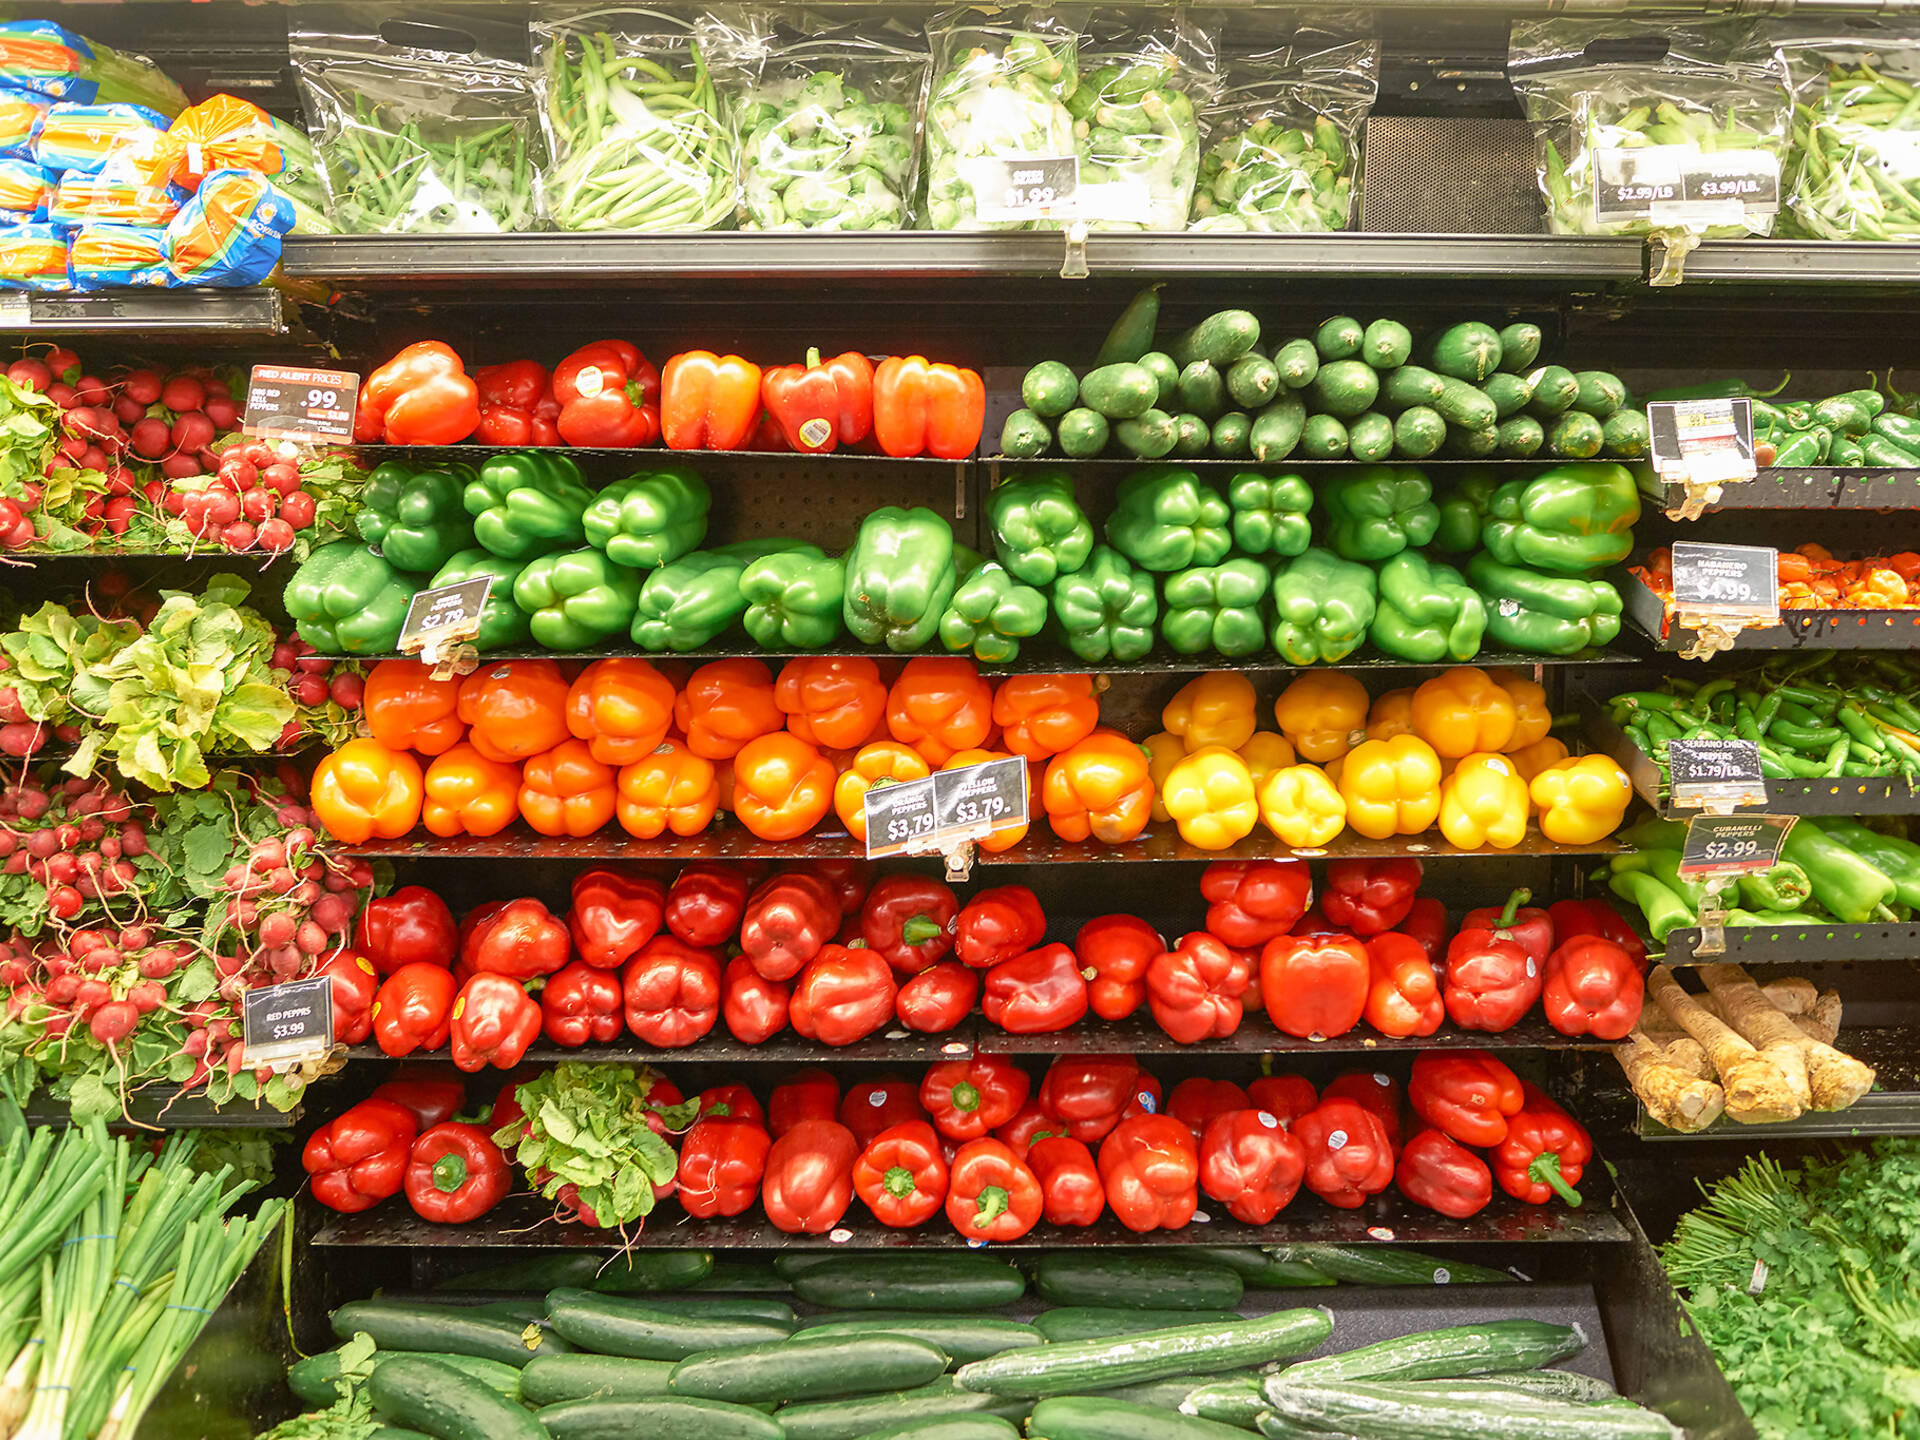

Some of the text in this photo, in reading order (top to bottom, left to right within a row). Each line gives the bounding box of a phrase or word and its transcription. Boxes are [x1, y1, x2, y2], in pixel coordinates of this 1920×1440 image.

[1617, 186, 1674, 202] $2.99/LB
[1701, 180, 1761, 197] $3.99/LB.
[258, 369, 342, 385] RED ALERT PRICES
[249, 403, 280, 411] PEPPERS
[1697, 560, 1748, 570] HABANERO
[1702, 568, 1744, 577] PEPPERS
[1697, 581, 1751, 601] $4.99
[420, 608, 464, 632] $2.79
[1684, 740, 1722, 749] SERRANO
[1688, 763, 1745, 778] $1.79/LB.
[961, 785, 998, 799] PEPPERS
[892, 801, 928, 816] PEPPERS
[956, 796, 1004, 823] $3.79
[887, 813, 934, 841] $3.79
[1704, 840, 1757, 860] $2.99
[266, 1006, 312, 1021] RED PEPPRS
[273, 1021, 305, 1039] $3.99
